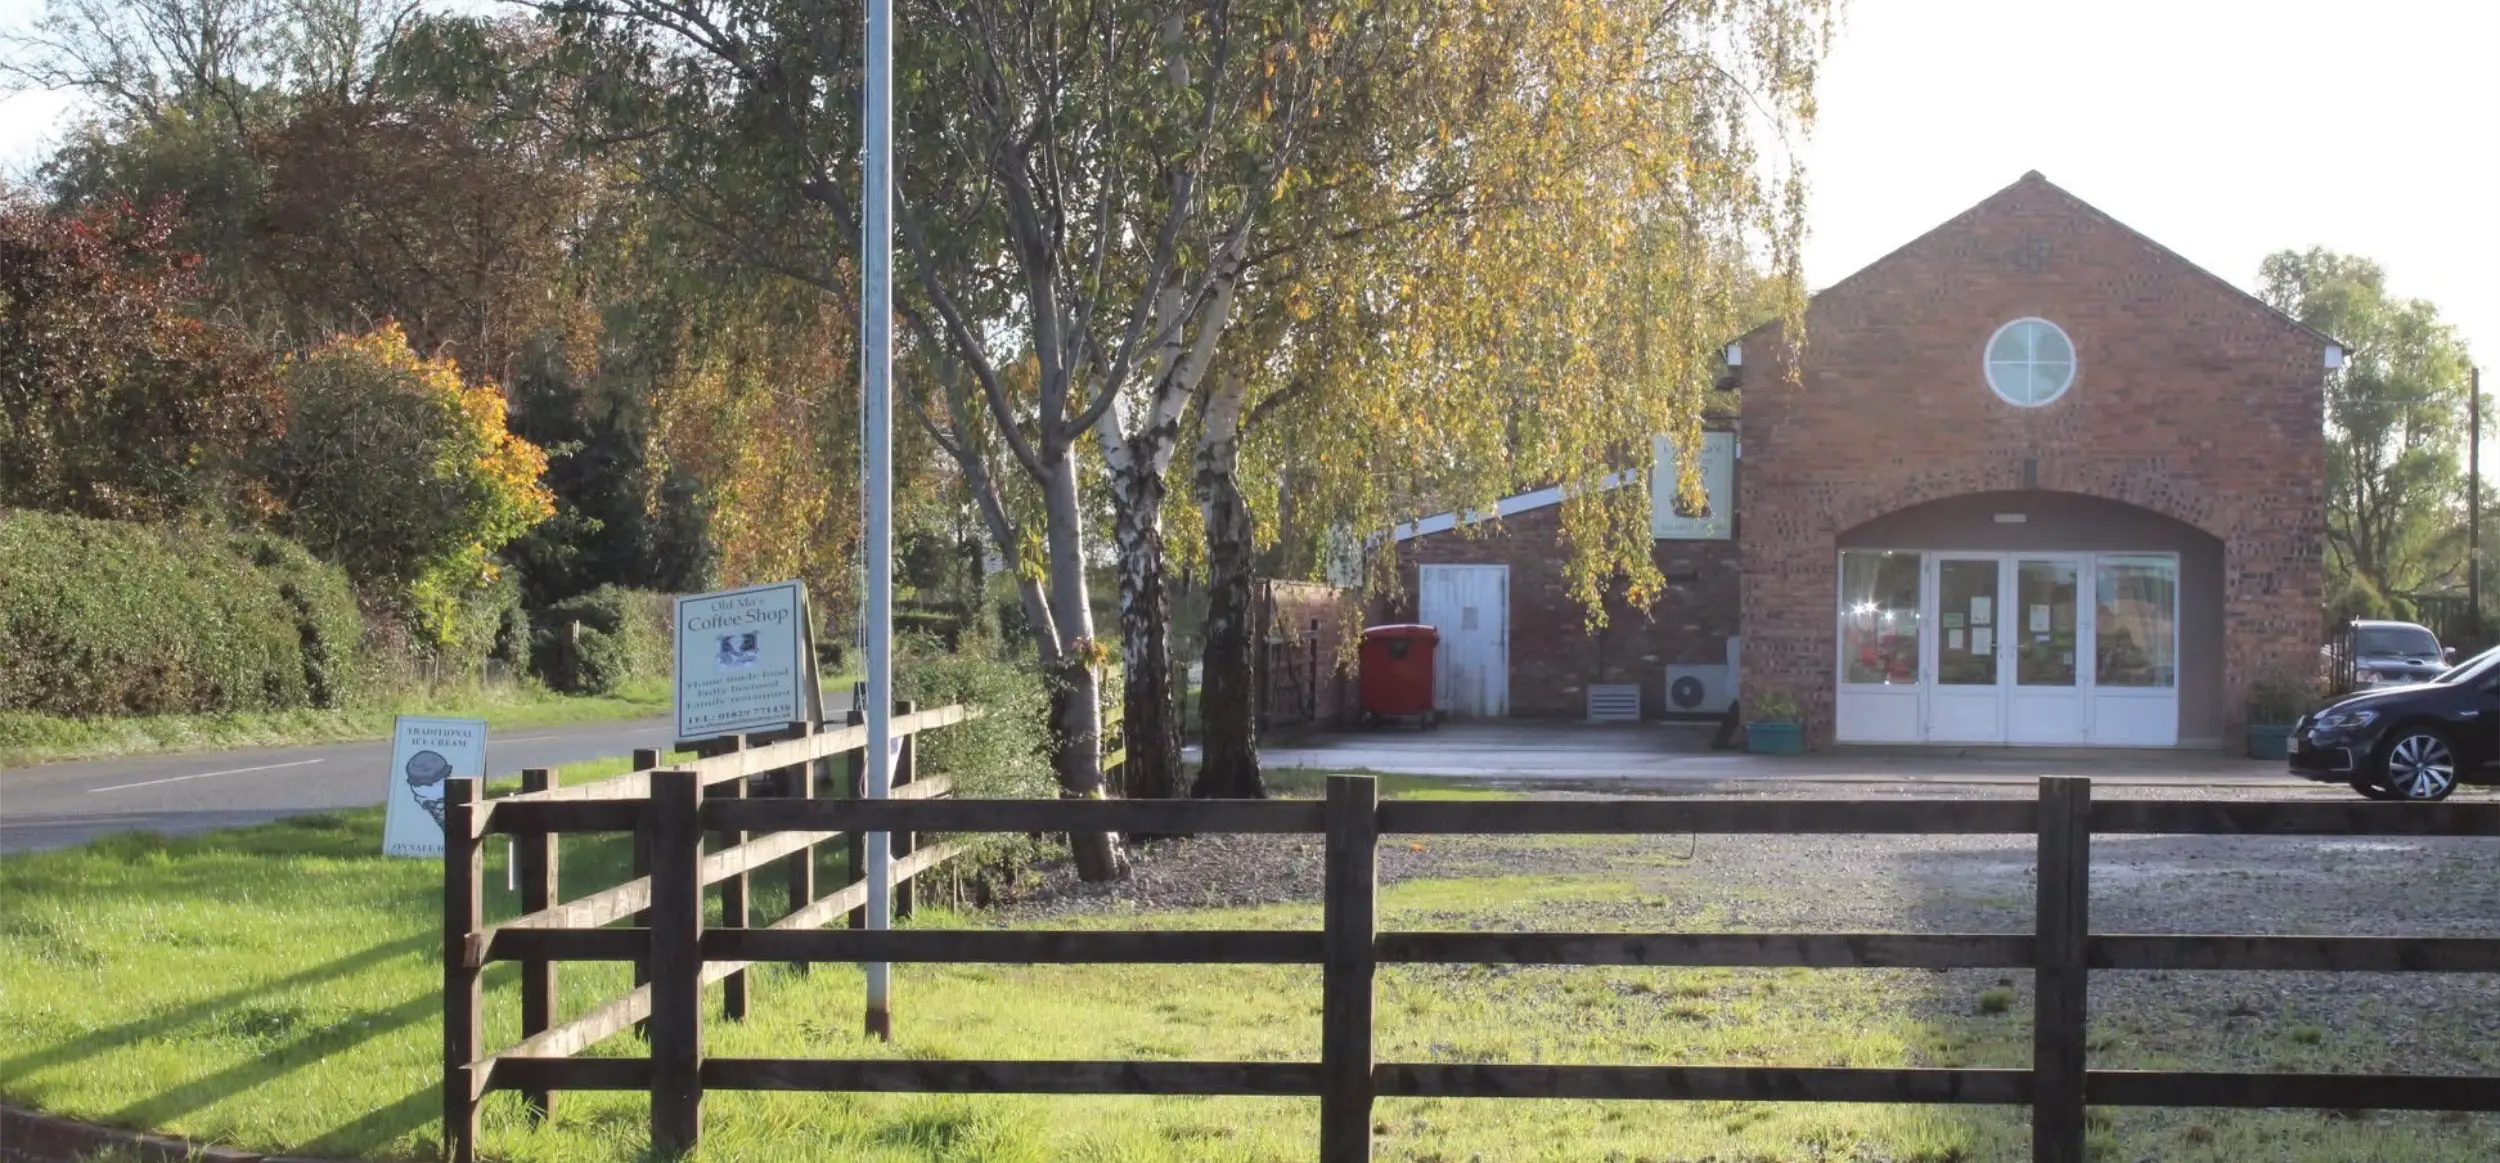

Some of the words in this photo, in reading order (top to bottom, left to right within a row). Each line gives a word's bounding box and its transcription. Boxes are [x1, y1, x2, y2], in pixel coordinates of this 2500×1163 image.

[711, 599, 733, 612] Old
[737, 596, 765, 608] Ma's
[688, 613, 742, 632] Coffee
[745, 608, 789, 625] Shop
[407, 727, 473, 738] TRADITIONAL
[412, 738, 427, 746] ICE
[430, 739, 468, 747] CREAM
